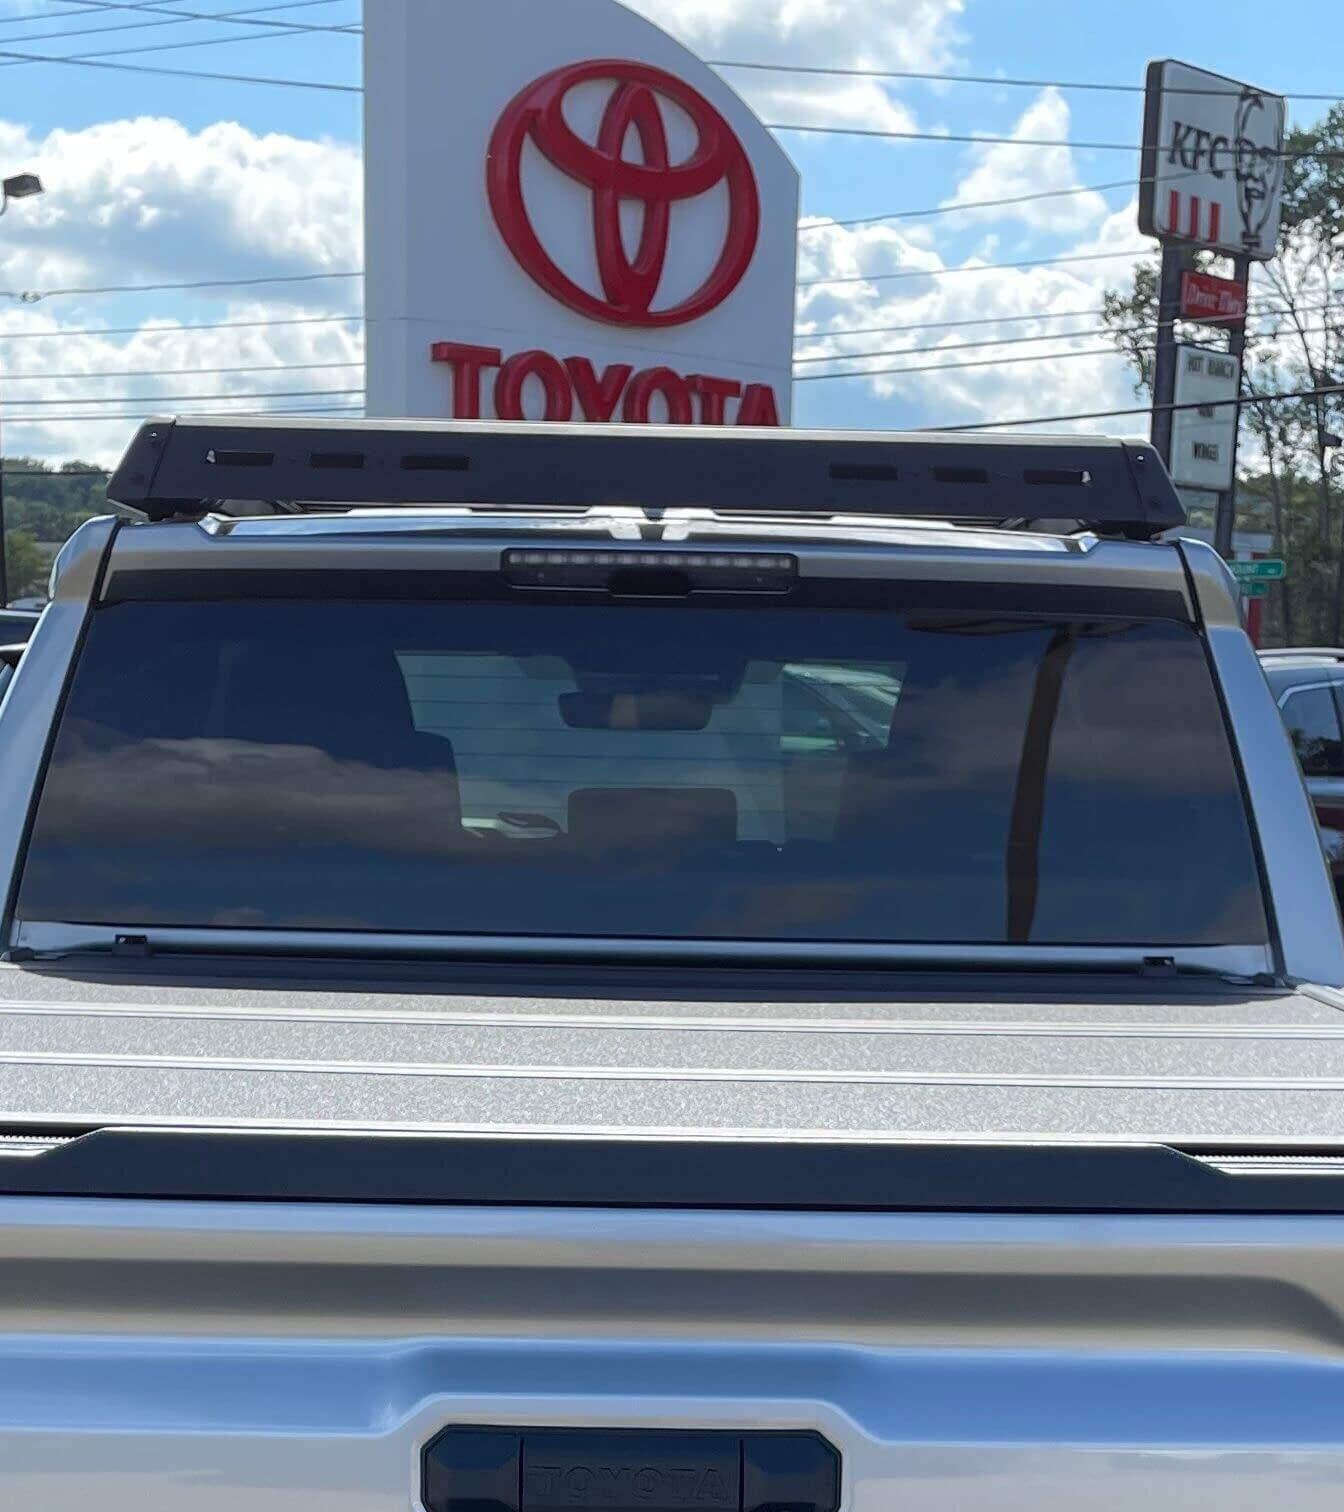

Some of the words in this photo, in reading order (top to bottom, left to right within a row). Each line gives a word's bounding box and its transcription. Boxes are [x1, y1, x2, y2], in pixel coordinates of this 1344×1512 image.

[1168, 121, 1229, 179] KFC
[430, 342, 780, 426] TOYOTA
[526, 1464, 729, 1502] TOYOTA
